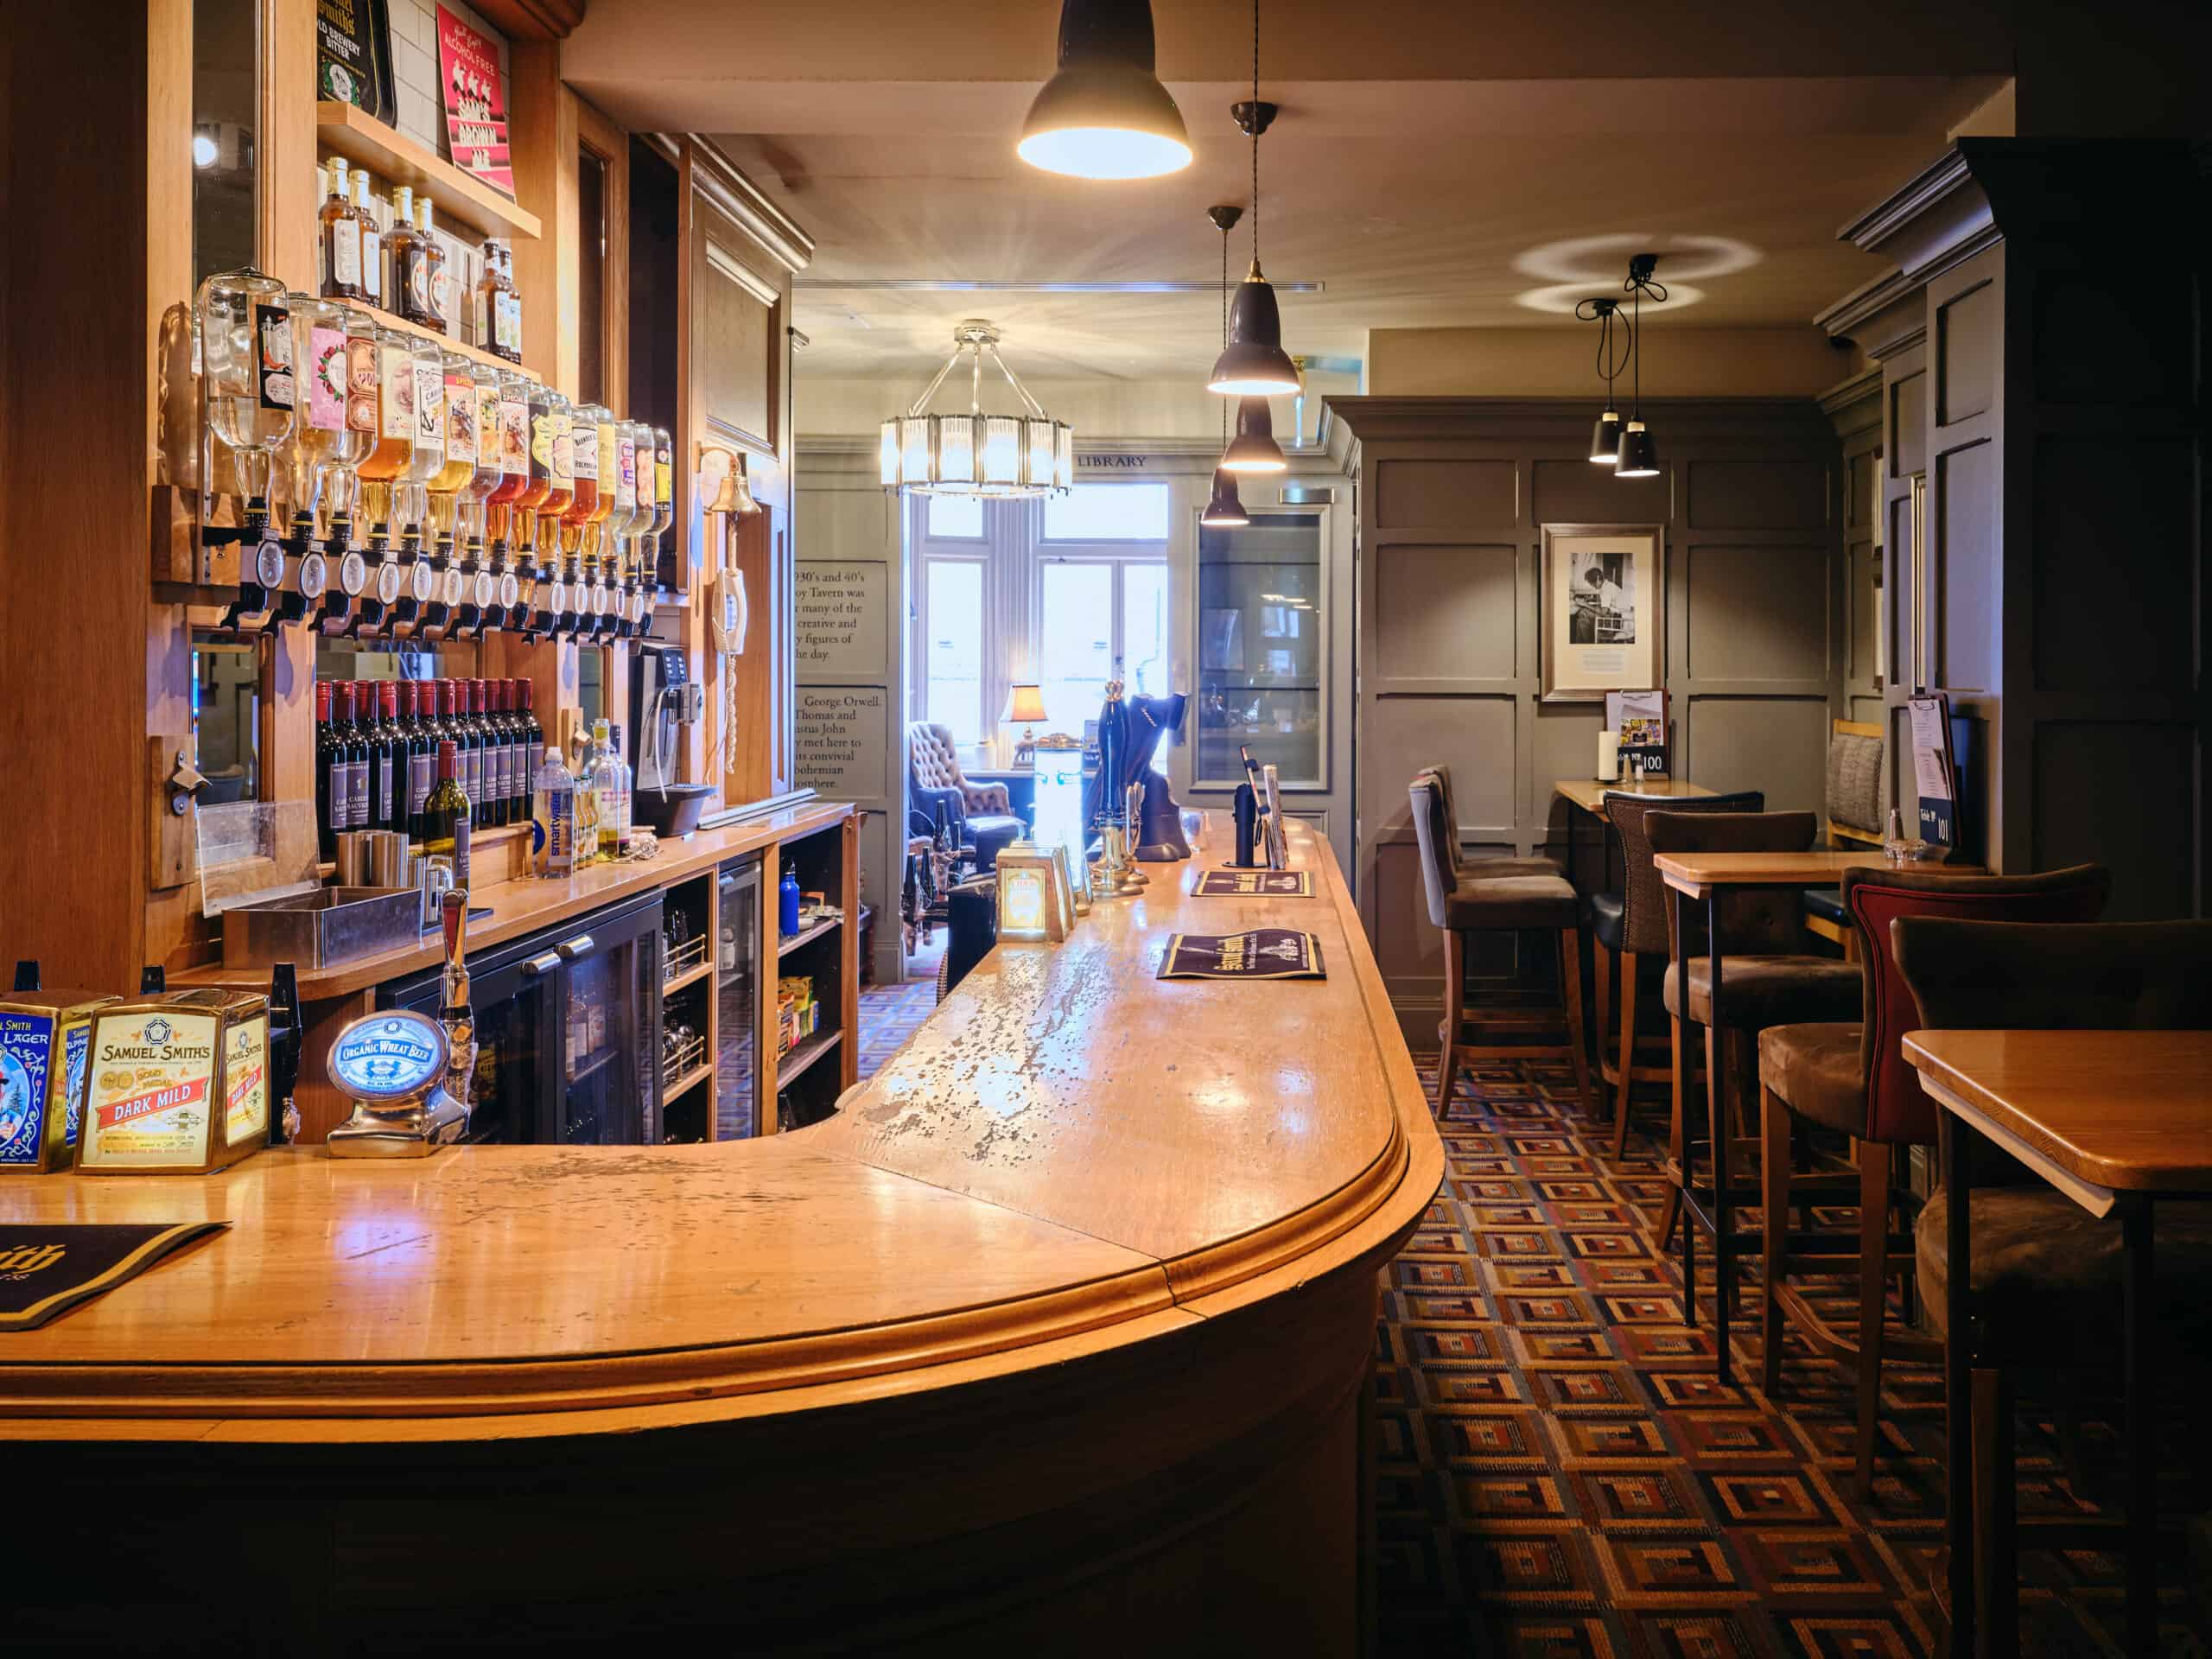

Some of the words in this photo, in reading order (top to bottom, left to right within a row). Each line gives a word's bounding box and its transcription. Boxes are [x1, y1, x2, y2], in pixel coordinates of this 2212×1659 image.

[326, 35, 350, 60] BITTER
[329, 27, 360, 57] BREWERY
[444, 31, 474, 64] ALCOHOL
[475, 54, 495, 77] FREE
[459, 123, 498, 147] BROWN
[472, 148, 491, 170] ALE
[1077, 456, 1146, 467] LIBRARY
[823, 571, 842, 582] and
[844, 571, 865, 582] 40's
[810, 588, 843, 597] Tavern
[802, 605, 830, 615] many
[833, 603, 842, 613] of
[847, 603, 863, 613] the
[798, 617, 836, 628] creative
[838, 617, 857, 628] and
[805, 632, 838, 645] figures
[842, 632, 855, 643] of
[810, 648, 830, 662] day.
[804, 696, 842, 709] George
[795, 709, 835, 719] Thomas
[837, 709, 856, 719] and
[821, 723, 846, 736] John
[827, 736, 848, 747] here
[810, 750, 855, 760] convivial
[1643, 755, 1662, 769] 100
[550, 790, 561, 856] smartwater
[1938, 817, 1948, 842] 101
[6, 1020, 31, 1031] SMITH
[4, 1033, 48, 1045] LAGER
[102, 1045, 157, 1061] SAMUEL
[160, 1045, 210, 1061] SMITH'S
[342, 1043, 378, 1060] ORGANIC
[380, 1040, 410, 1054] WHEAT
[408, 1044, 430, 1060] BEER
[226, 1052, 245, 1065] SAMUEL
[231, 1085, 245, 1104] DARK
[245, 1072, 257, 1090] MILD
[114, 1096, 152, 1121] DARK
[156, 1085, 191, 1108] MILD
